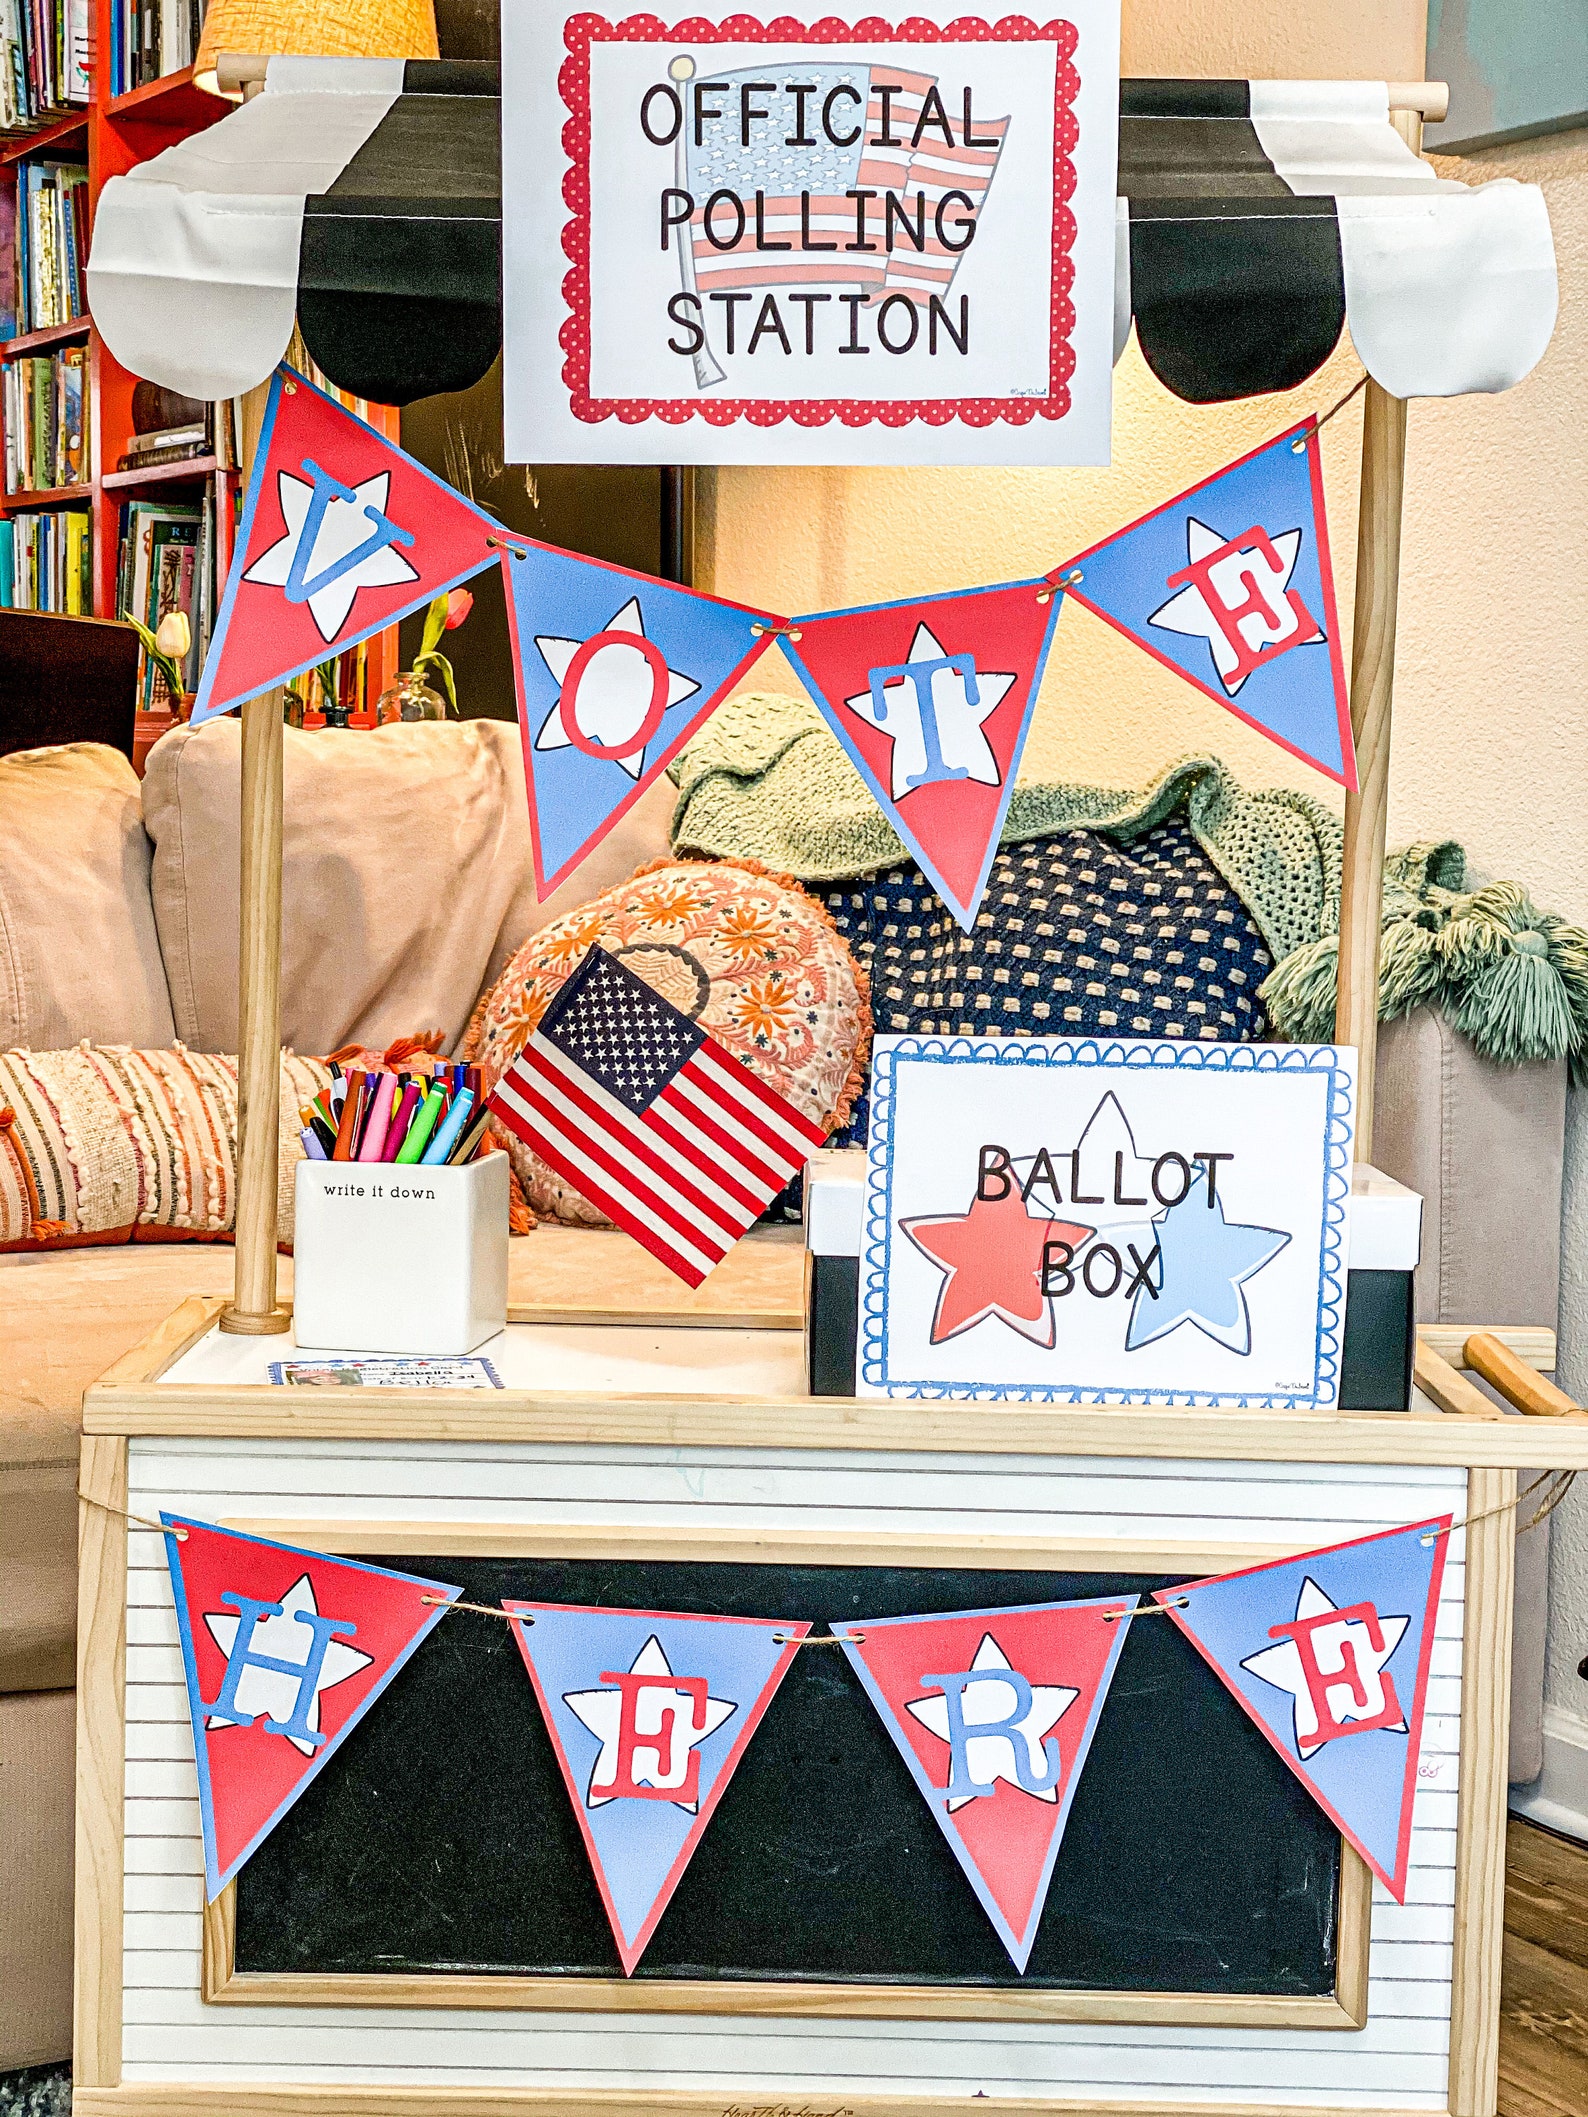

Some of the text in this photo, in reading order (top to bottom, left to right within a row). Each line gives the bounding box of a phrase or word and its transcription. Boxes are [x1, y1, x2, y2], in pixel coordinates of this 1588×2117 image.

[640, 82, 1000, 149] OFFICIAL
[660, 188, 978, 252] POLLING
[666, 291, 970, 356] STATION
[324, 1184, 436, 1200] write it down
[977, 1144, 1235, 1209] BALLOT
[1040, 1240, 1162, 1301] BOX
